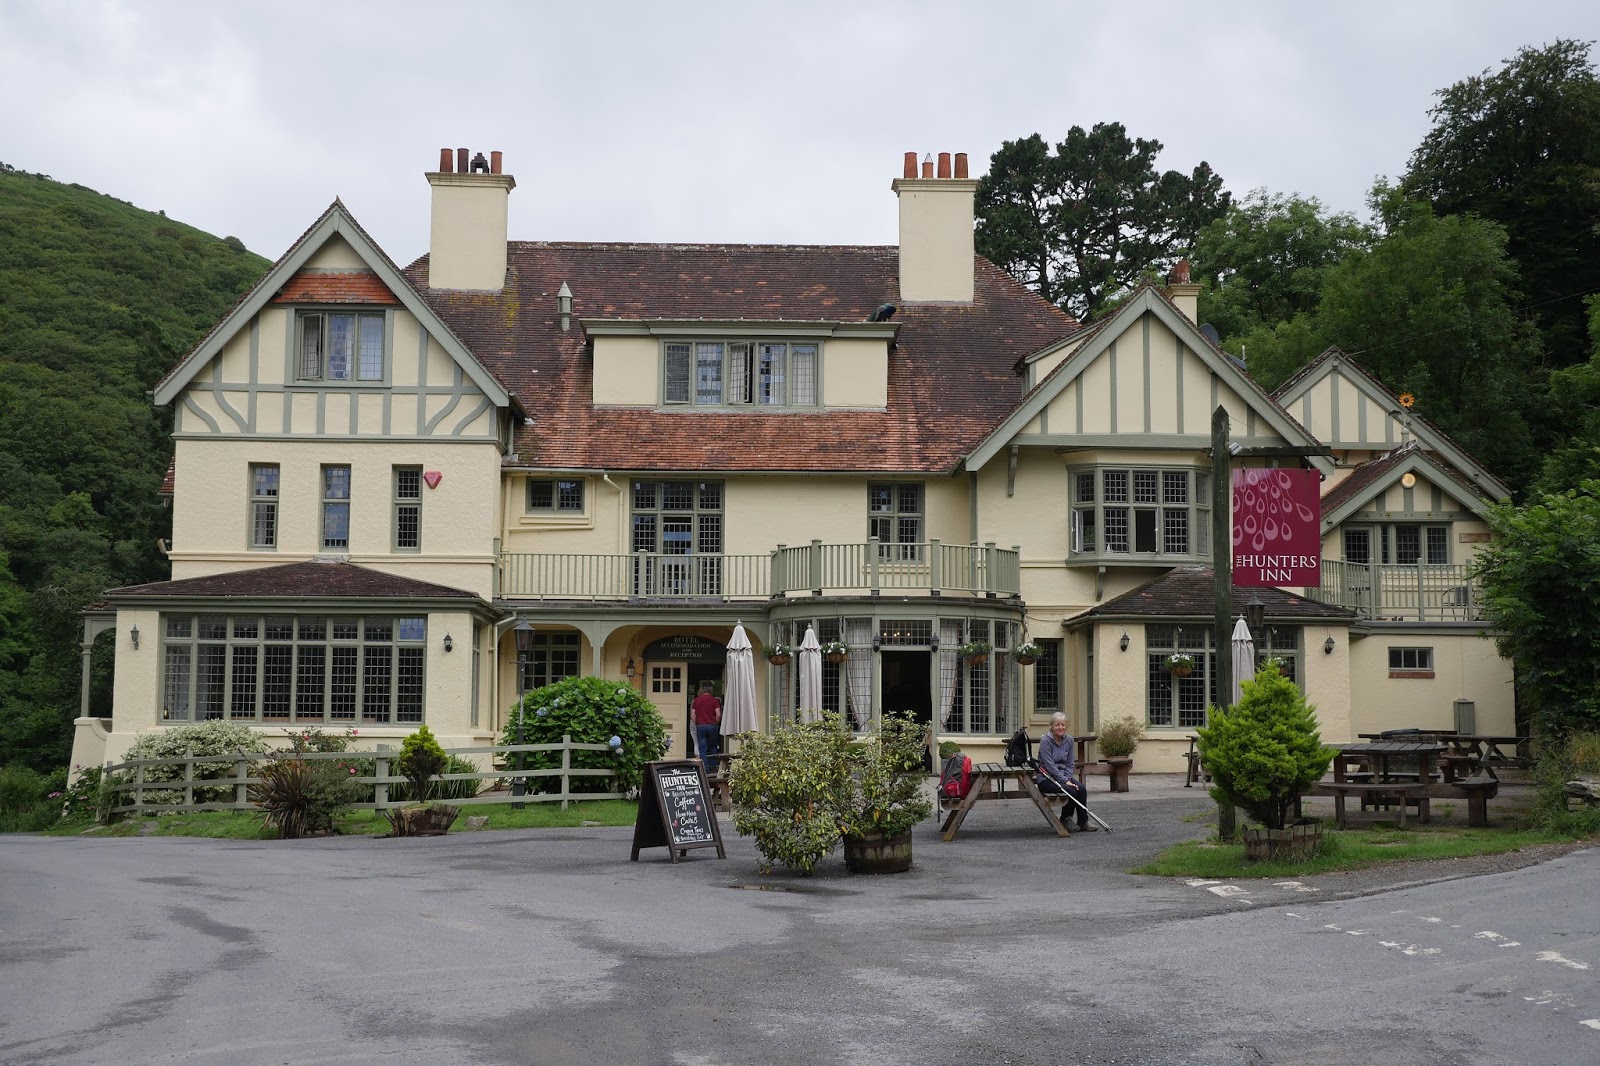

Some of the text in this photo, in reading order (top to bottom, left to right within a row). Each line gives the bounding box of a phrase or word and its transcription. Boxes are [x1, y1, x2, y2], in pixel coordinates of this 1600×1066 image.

[1242, 554, 1317, 568] HUNTERS
[1260, 568, 1292, 582] INN
[673, 636, 699, 644] HOTEL
[661, 775, 699, 789] HUNTERS
